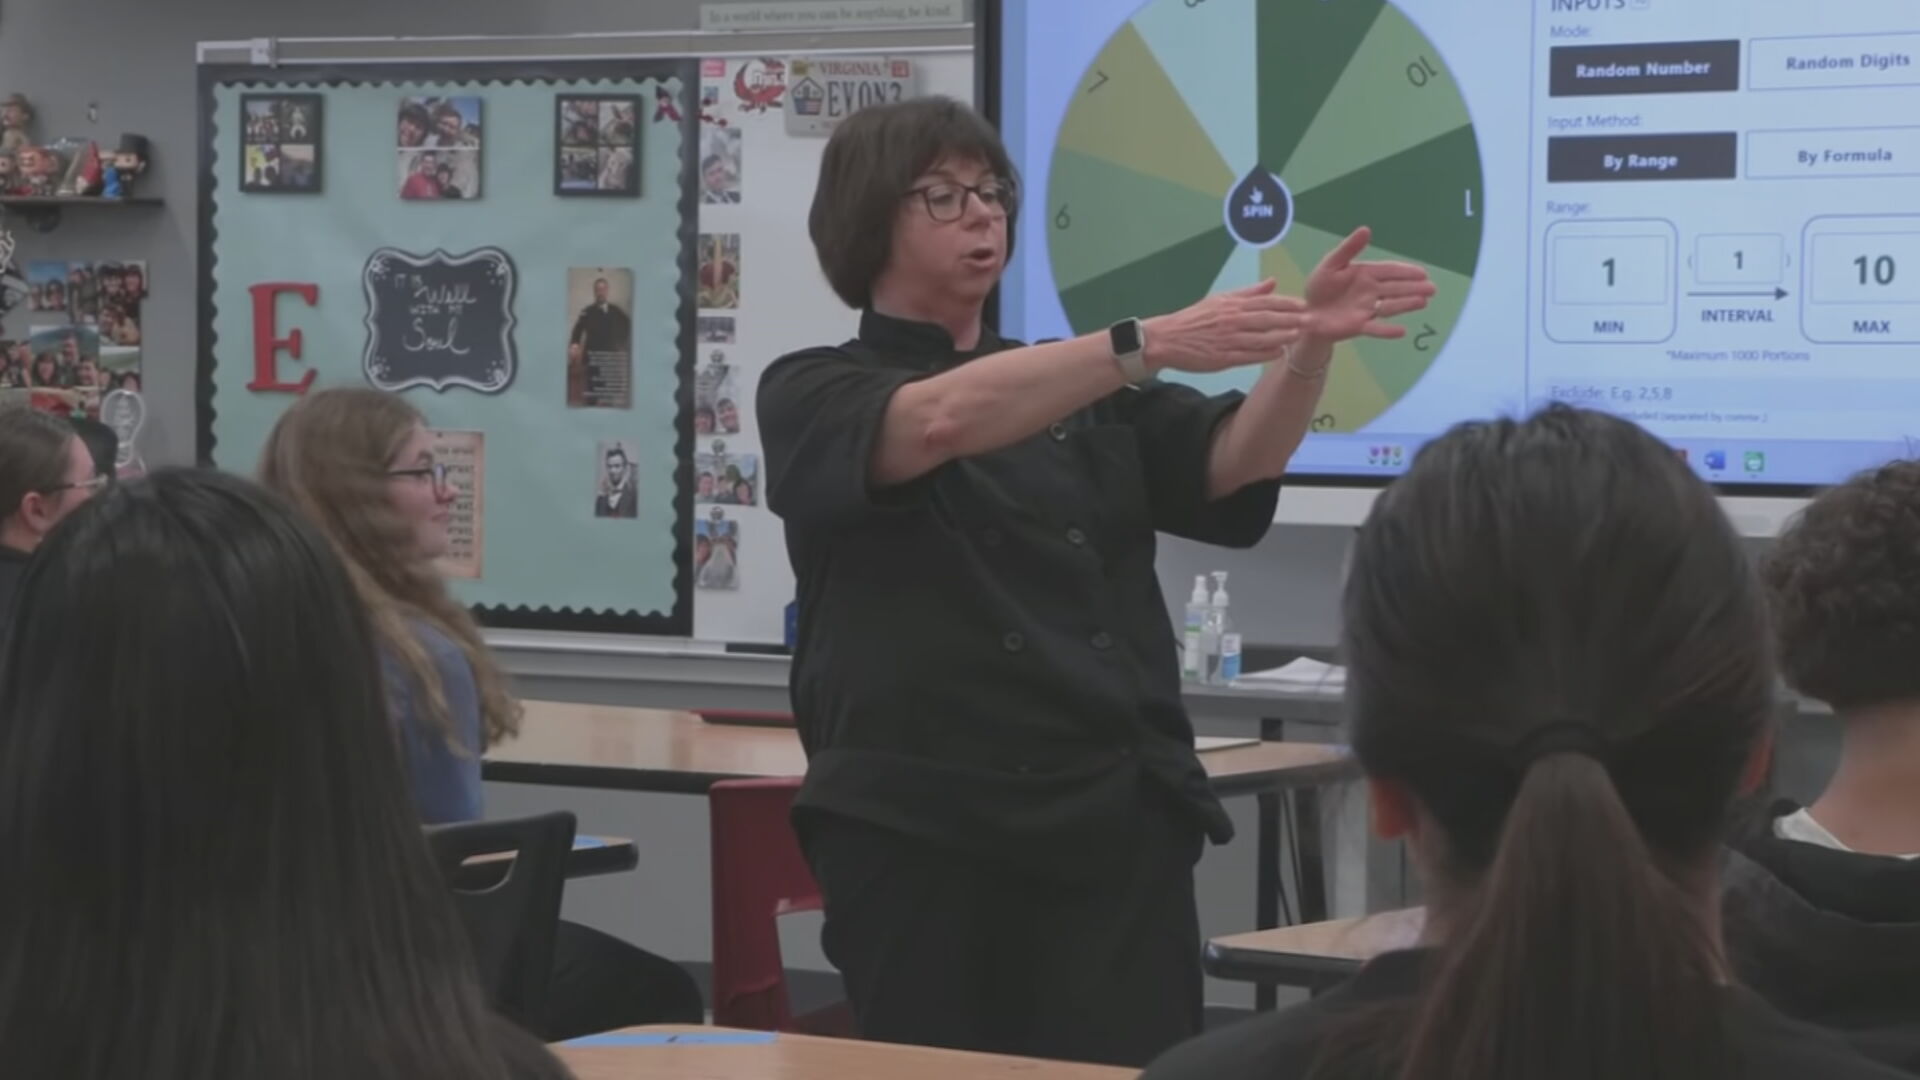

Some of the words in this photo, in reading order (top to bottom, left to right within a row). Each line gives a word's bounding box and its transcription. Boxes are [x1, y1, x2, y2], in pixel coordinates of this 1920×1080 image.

[1550, 26, 1591, 38] Mode:
[819, 61, 882, 76] VIRGINIA
[1576, 64, 1640, 78] Random
[1646, 61, 1711, 76] Number
[1786, 55, 1853, 70] Random
[1860, 53, 1910, 70] Digits
[1548, 116, 1584, 129] Input
[1587, 115, 1641, 127] Method:
[1603, 155, 1623, 171] By
[1628, 154, 1678, 170] Range
[1798, 150, 1818, 166] By
[1824, 149, 1892, 162] Formula
[1242, 205, 1273, 219] SPIN
[1547, 201, 1590, 216] Range:
[1733, 251, 1744, 270] 1
[1602, 258, 1616, 287] 1
[1853, 255, 1895, 286] 10
[1701, 310, 1774, 323] INTERVAL
[402, 317, 470, 354] Soul
[1594, 321, 1624, 334] MIN
[1853, 321, 1891, 334] MAX
[246, 282, 320, 394] E
[1413, 324, 1438, 351] 2
[1732, 350, 1759, 361] 1000
[1762, 350, 1810, 361] Portions
